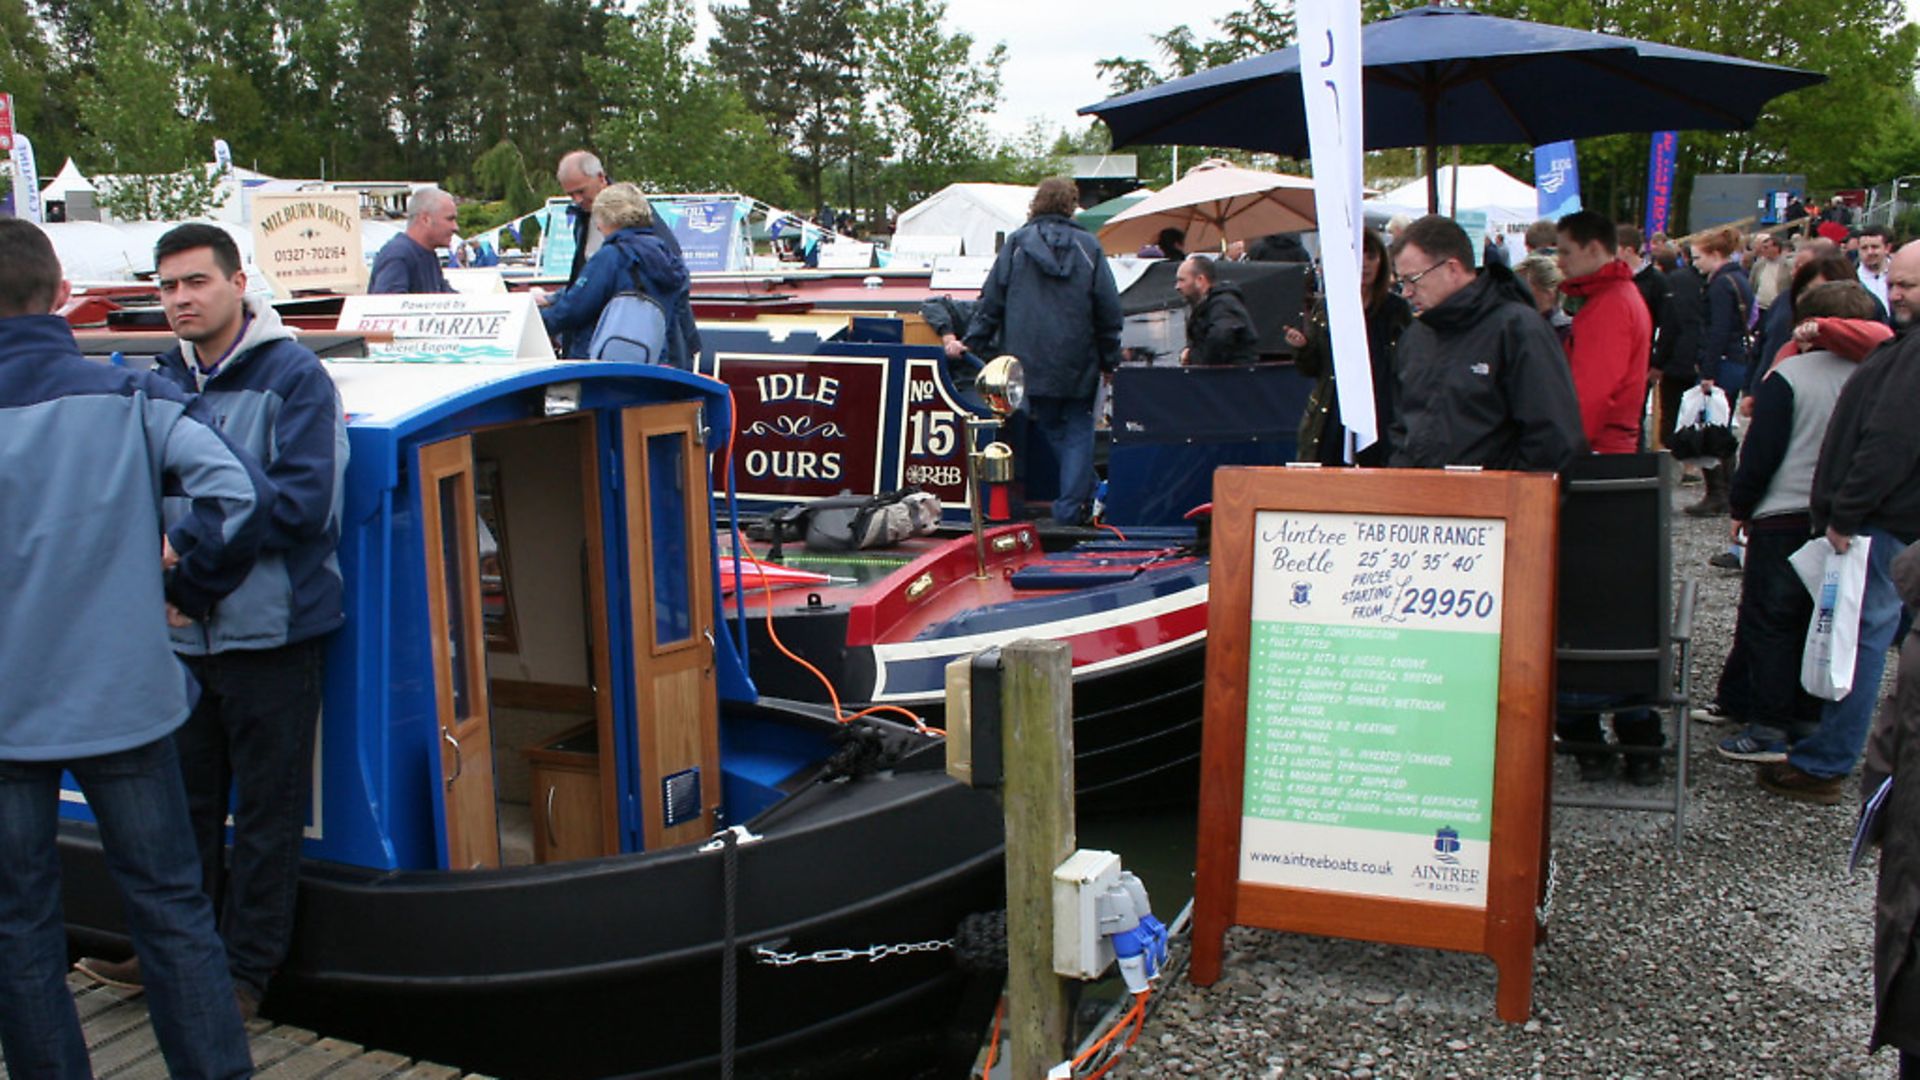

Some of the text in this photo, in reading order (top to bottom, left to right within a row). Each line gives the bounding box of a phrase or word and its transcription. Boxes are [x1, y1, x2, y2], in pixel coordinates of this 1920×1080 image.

[261, 202, 351, 237] MILBURN BOATS
[401, 299, 466, 310] Powered by
[416, 316, 507, 335] MARINE
[384, 341, 460, 354] Diesel Engine
[757, 374, 839, 405] IDLE
[910, 410, 955, 456] 15
[745, 450, 841, 480] OURS
[1263, 520, 1347, 546] Aintree
[1390, 524, 1429, 544] FOUR
[1272, 547, 1334, 574] Beetle
[1352, 570, 1391, 587] PRICES
[1342, 586, 1392, 605] STARTING
[1352, 604, 1384, 619] FROM
[1250, 851, 1393, 876] www.aintreeboats.co.uk
[1411, 864, 1481, 885] AINTREE
[1428, 882, 1461, 893] BOATS
